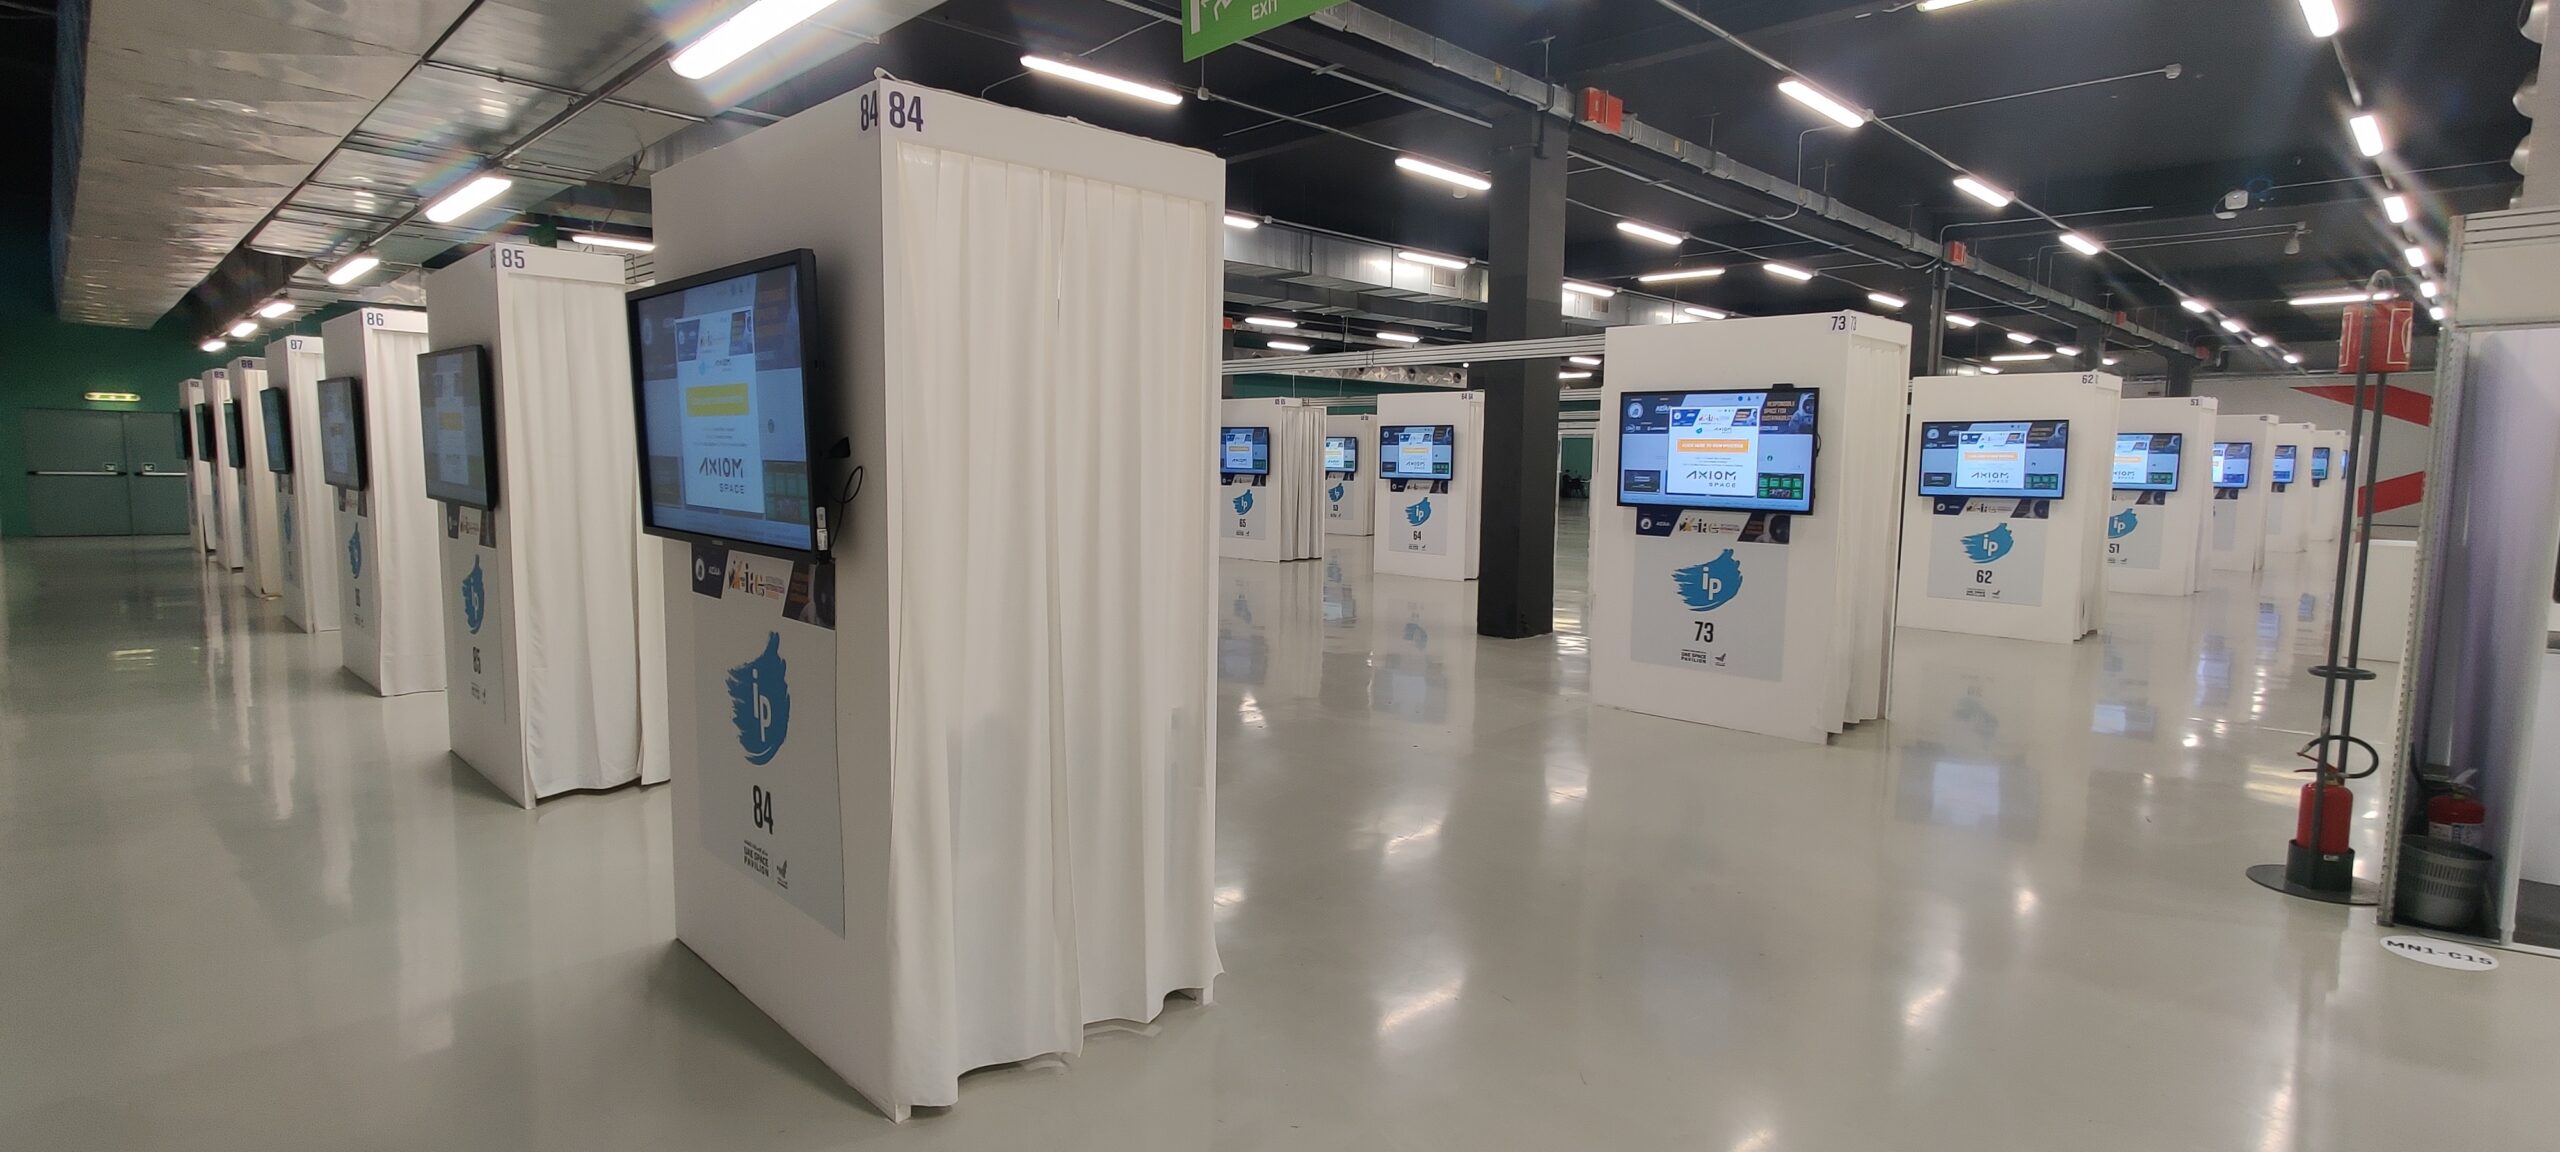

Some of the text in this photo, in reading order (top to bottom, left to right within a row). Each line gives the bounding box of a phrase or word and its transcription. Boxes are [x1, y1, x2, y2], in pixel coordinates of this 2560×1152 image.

[861, 90, 878, 132] 84
[889, 91, 924, 132] 84
[502, 249, 525, 269] 85
[366, 313, 384, 326] 86
[1831, 315, 1846, 331] 73
[290, 340, 303, 350] 87
[2082, 375, 2094, 384] 62
[700, 457, 744, 478] AXIOM
[1686, 470, 1737, 480] AXIOM
[720, 483, 745, 494] SPACE
[2113, 517, 2126, 533] ip
[1413, 531, 1421, 540] 64
[1983, 534, 1999, 557] ip
[2108, 543, 2120, 553] 51
[1702, 566, 1722, 601] ip
[1976, 570, 1993, 584] 62
[1694, 621, 1714, 643] 73
[1681, 656, 1707, 664] PAVILION
[752, 668, 772, 743] ip
[753, 785, 774, 835] 84
[744, 856, 769, 877] PAVILION
[2387, 940, 2493, 965] MN1-C15
